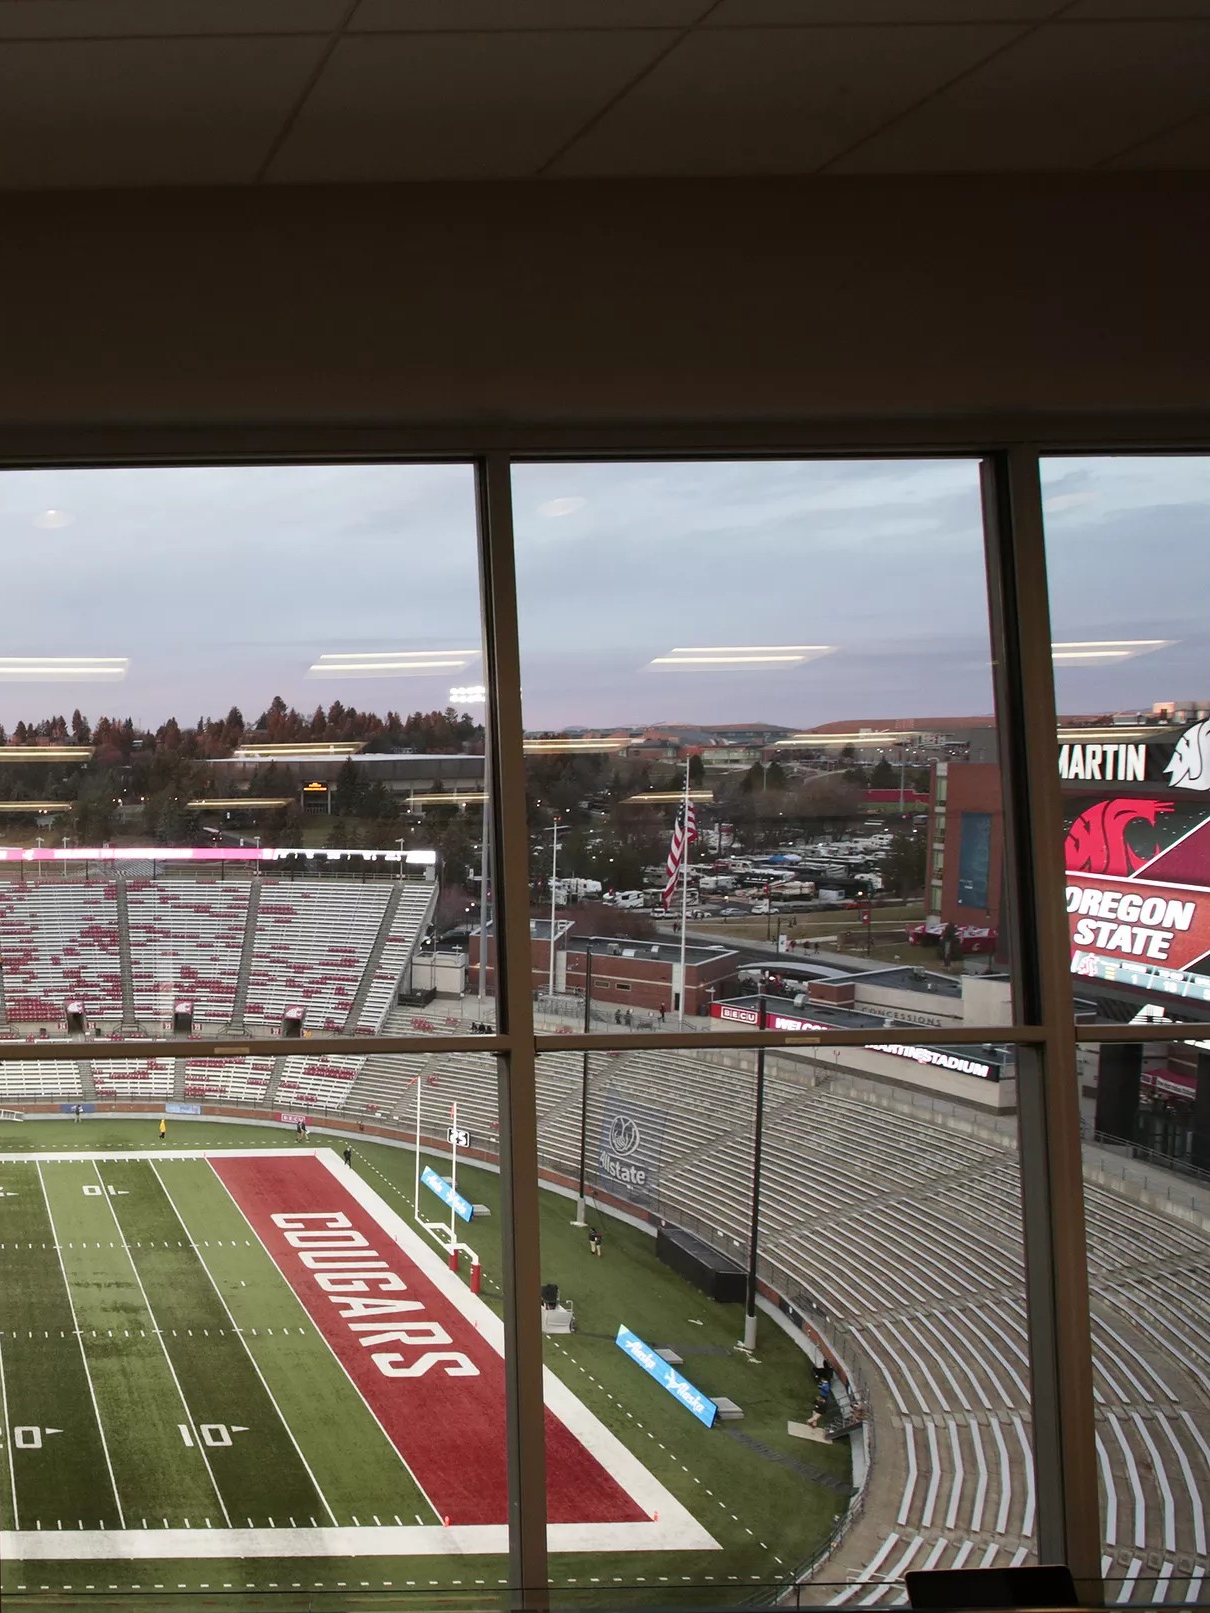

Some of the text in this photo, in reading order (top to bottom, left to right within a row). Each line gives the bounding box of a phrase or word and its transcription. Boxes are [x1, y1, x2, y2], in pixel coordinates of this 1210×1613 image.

[1065, 886, 1196, 931] OREGON
[1073, 918, 1175, 960] STATE
[723, 1008, 755, 1021] BECU
[861, 1007, 942, 1027] CONCESSIONS
[921, 1049, 990, 1077] STADIUM
[599, 1150, 646, 1184] Allstate
[270, 1211, 481, 1378] COUGARS
[177, 1423, 233, 1447] 10
